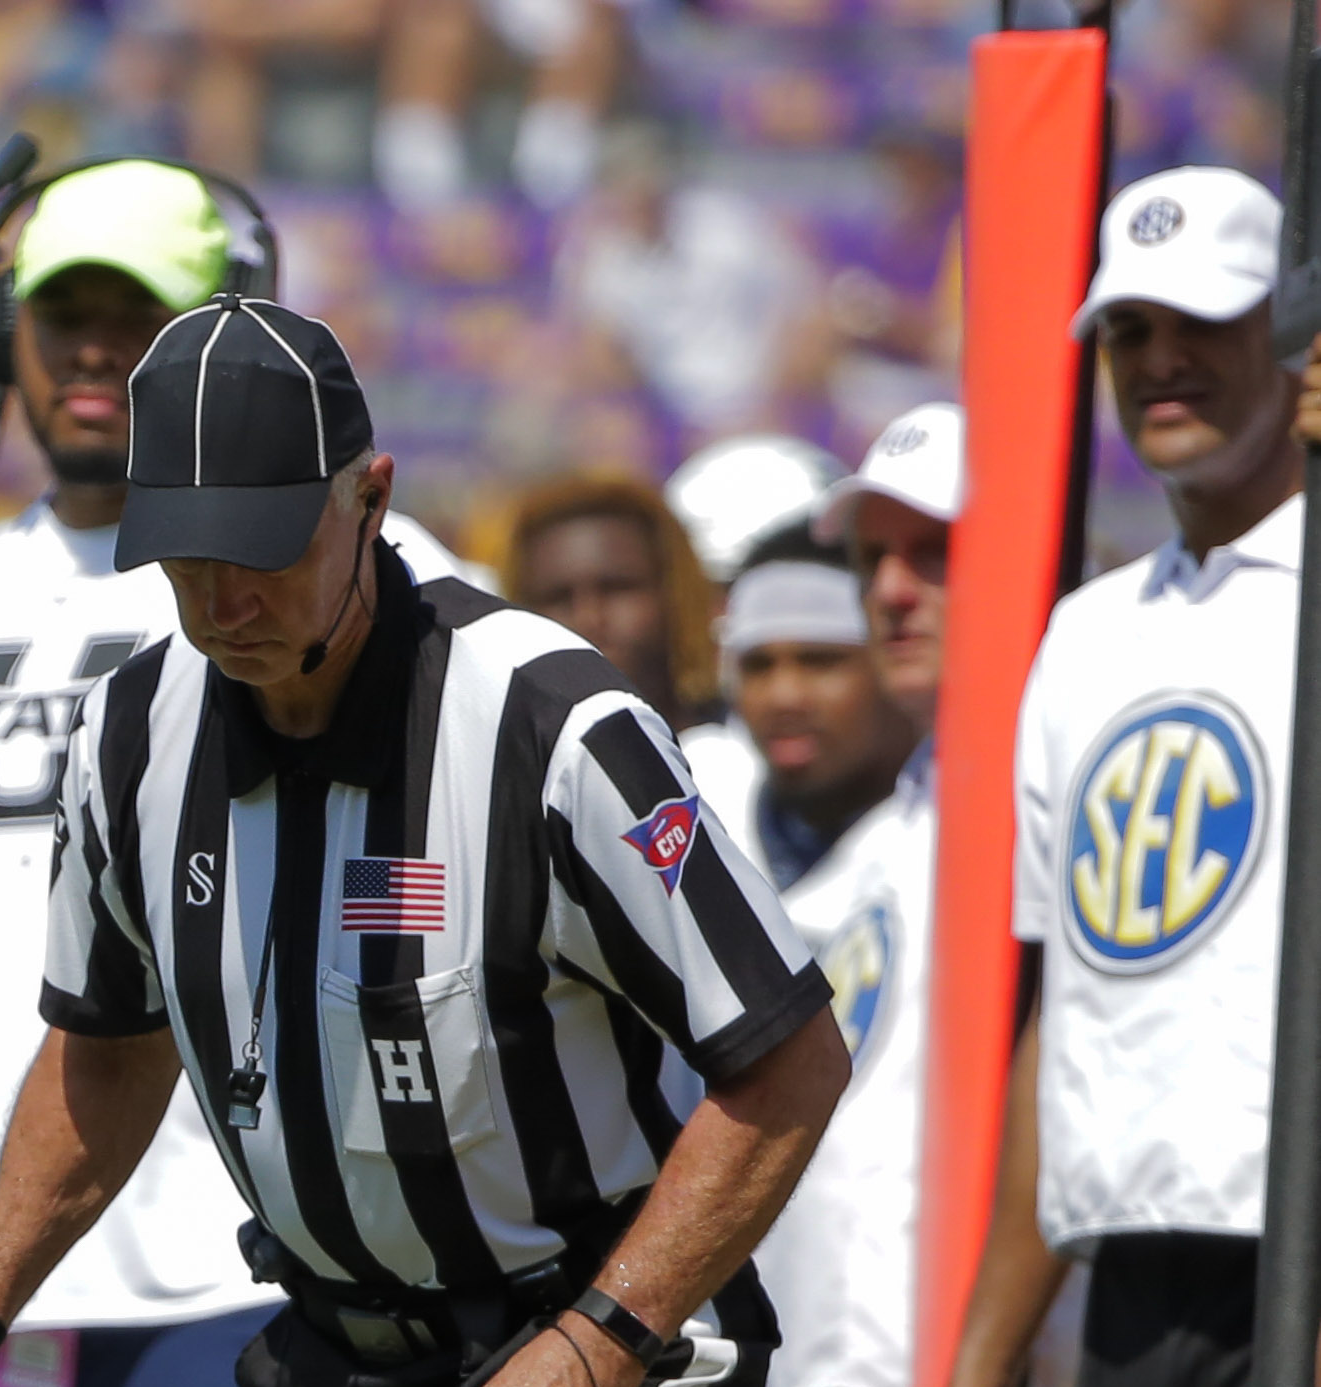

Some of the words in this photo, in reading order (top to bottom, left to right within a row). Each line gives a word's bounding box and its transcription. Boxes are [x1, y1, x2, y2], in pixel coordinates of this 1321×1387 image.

[654, 824, 688, 859] CFO
[1073, 719, 1242, 948] SEC
[372, 1039, 433, 1103] H
